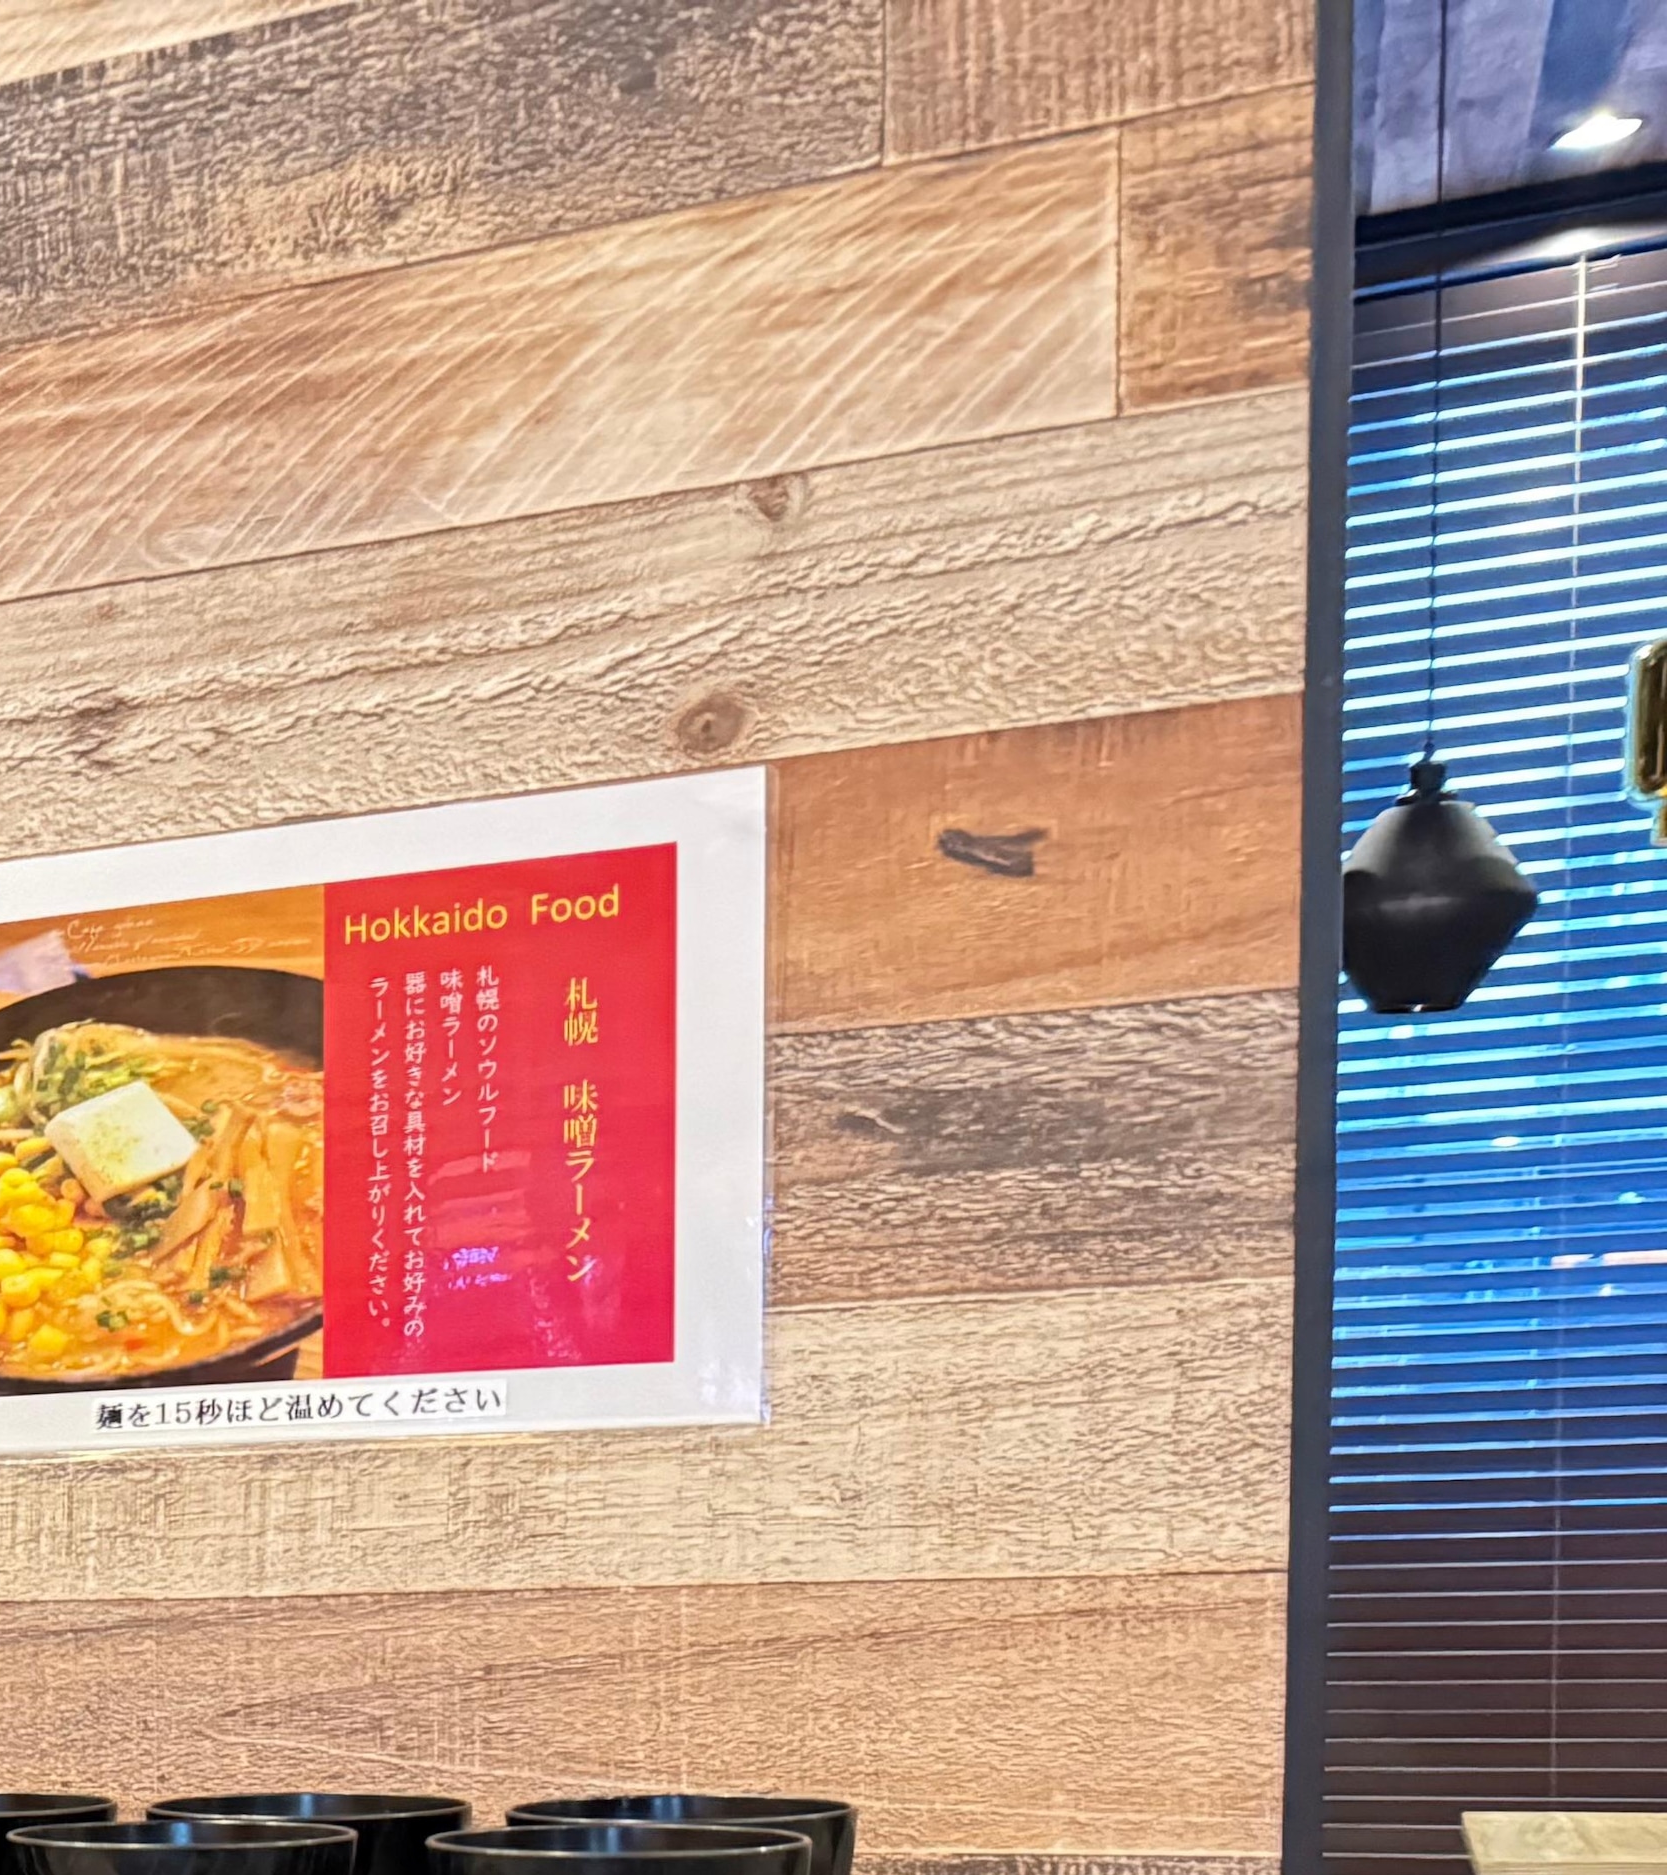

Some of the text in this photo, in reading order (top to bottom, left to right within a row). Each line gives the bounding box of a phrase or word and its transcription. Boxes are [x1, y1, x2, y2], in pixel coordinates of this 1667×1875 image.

[344, 897, 508, 945] Hokkaido
[531, 883, 620, 925] Food
[440, 970, 463, 1106] 味噌ラーメン
[476, 966, 500, 1173] 札幌のソウルフード
[562, 977, 599, 1282] 札幌 味噌ラーメン
[368, 977, 392, 1327] ラーメンをお召し上がりください。
[403, 971, 427, 1337] 器にお好きな具材を入れてお好みの
[96, 1387, 501, 1430] 麺を15秒ほど温めてください
